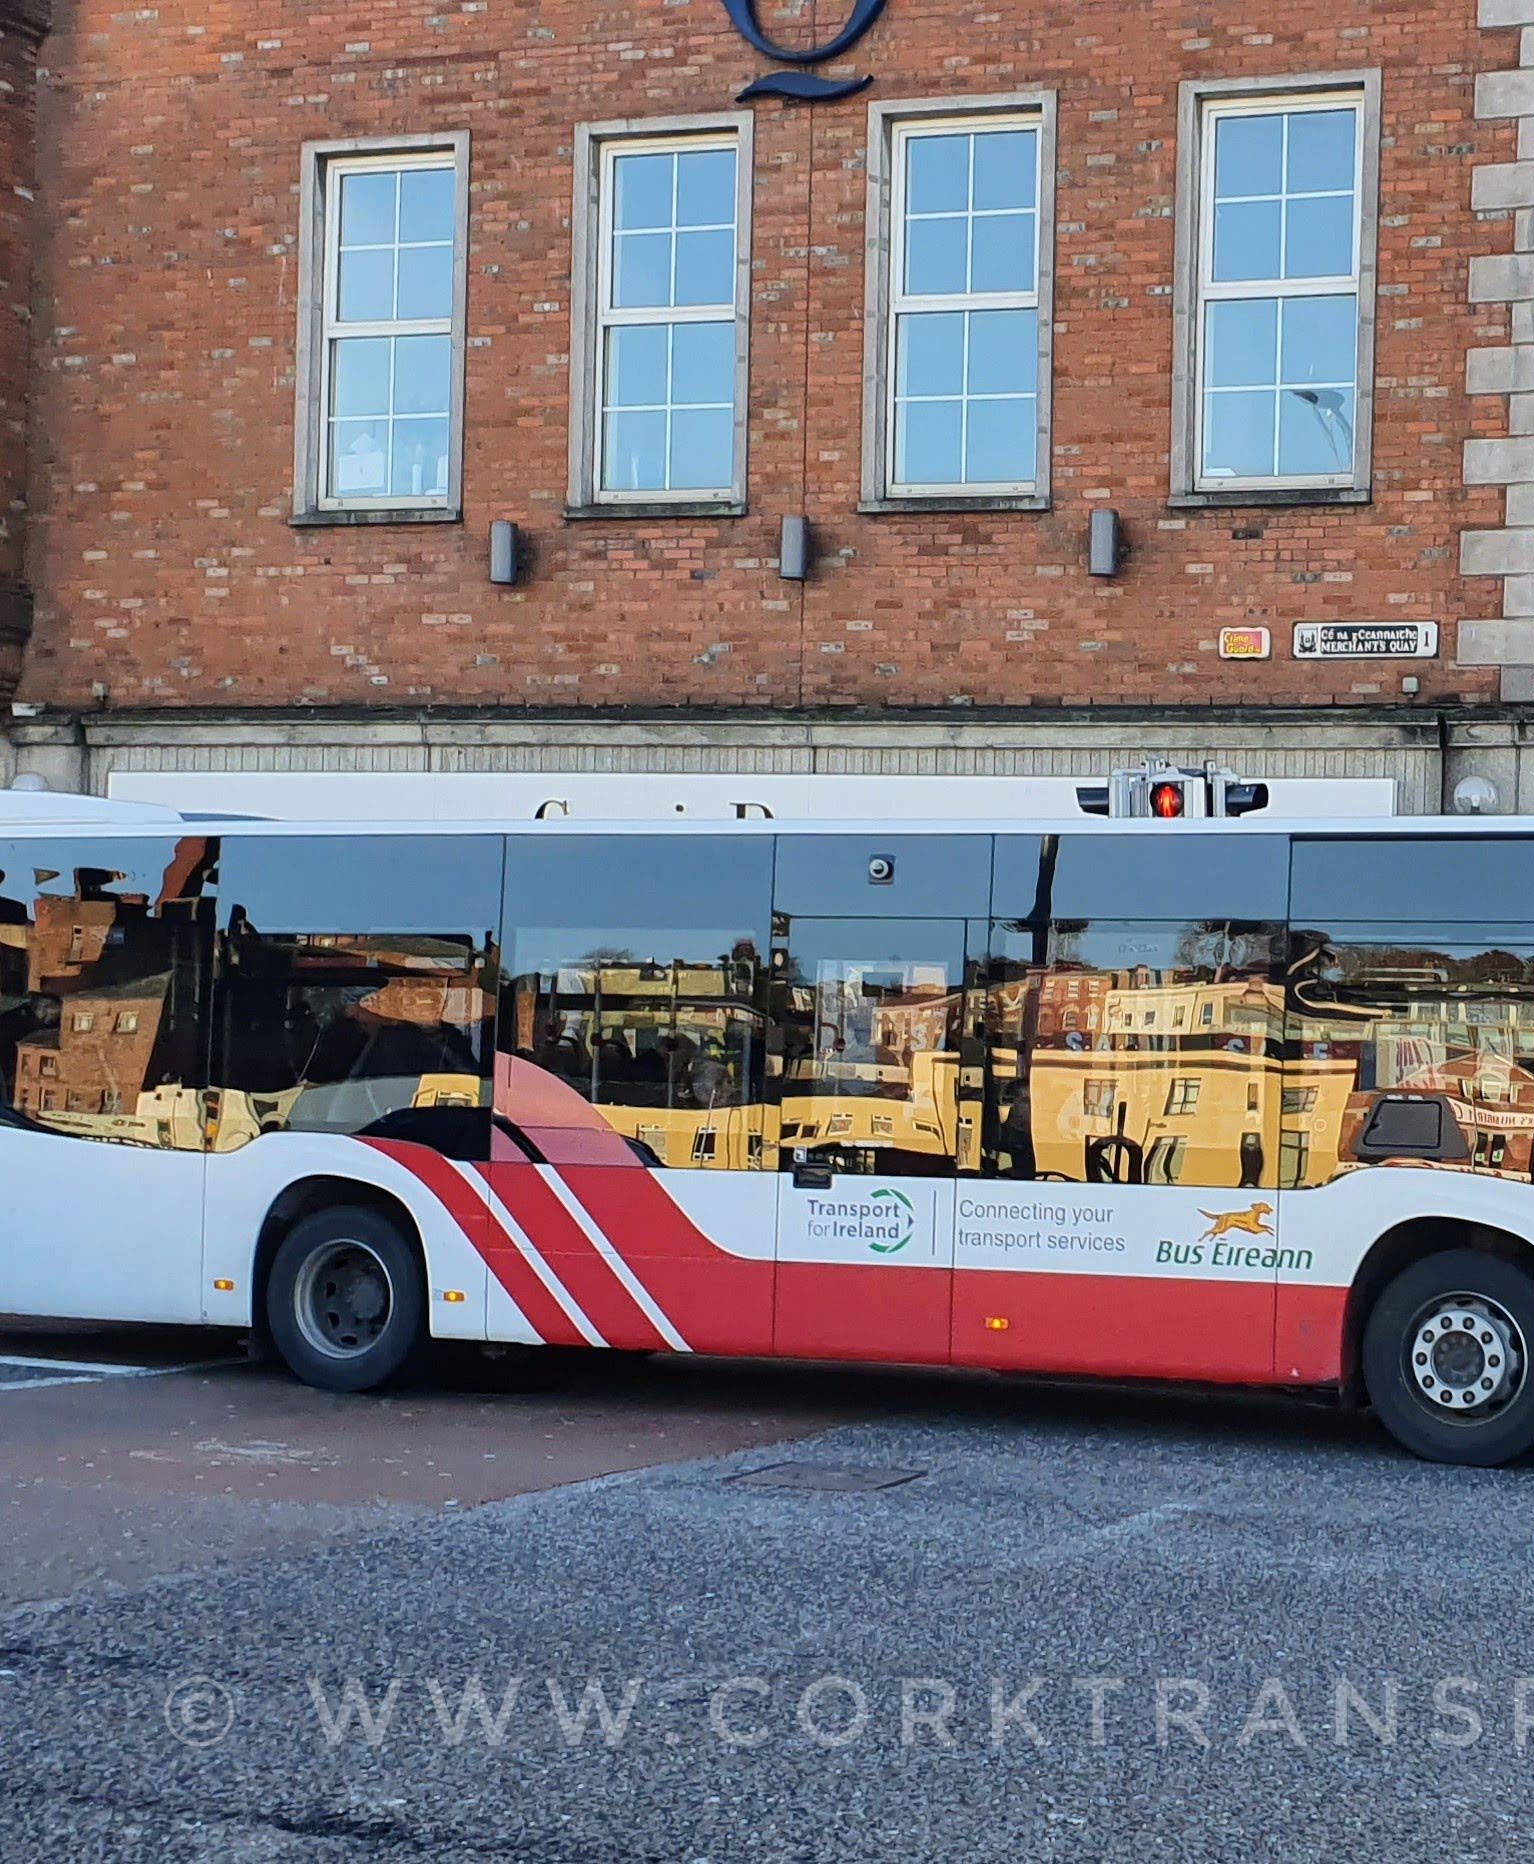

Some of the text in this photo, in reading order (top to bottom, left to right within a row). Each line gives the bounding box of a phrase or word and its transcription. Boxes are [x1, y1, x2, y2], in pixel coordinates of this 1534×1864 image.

[1321, 640, 1416, 652] MERCHANTS QUAY
[807, 1199, 900, 1219] Transport
[959, 1199, 1115, 1227] Connecting your
[807, 1220, 900, 1239] for Ireland
[958, 1228, 1126, 1252] transport services
[1155, 1239, 1205, 1265] Bus
